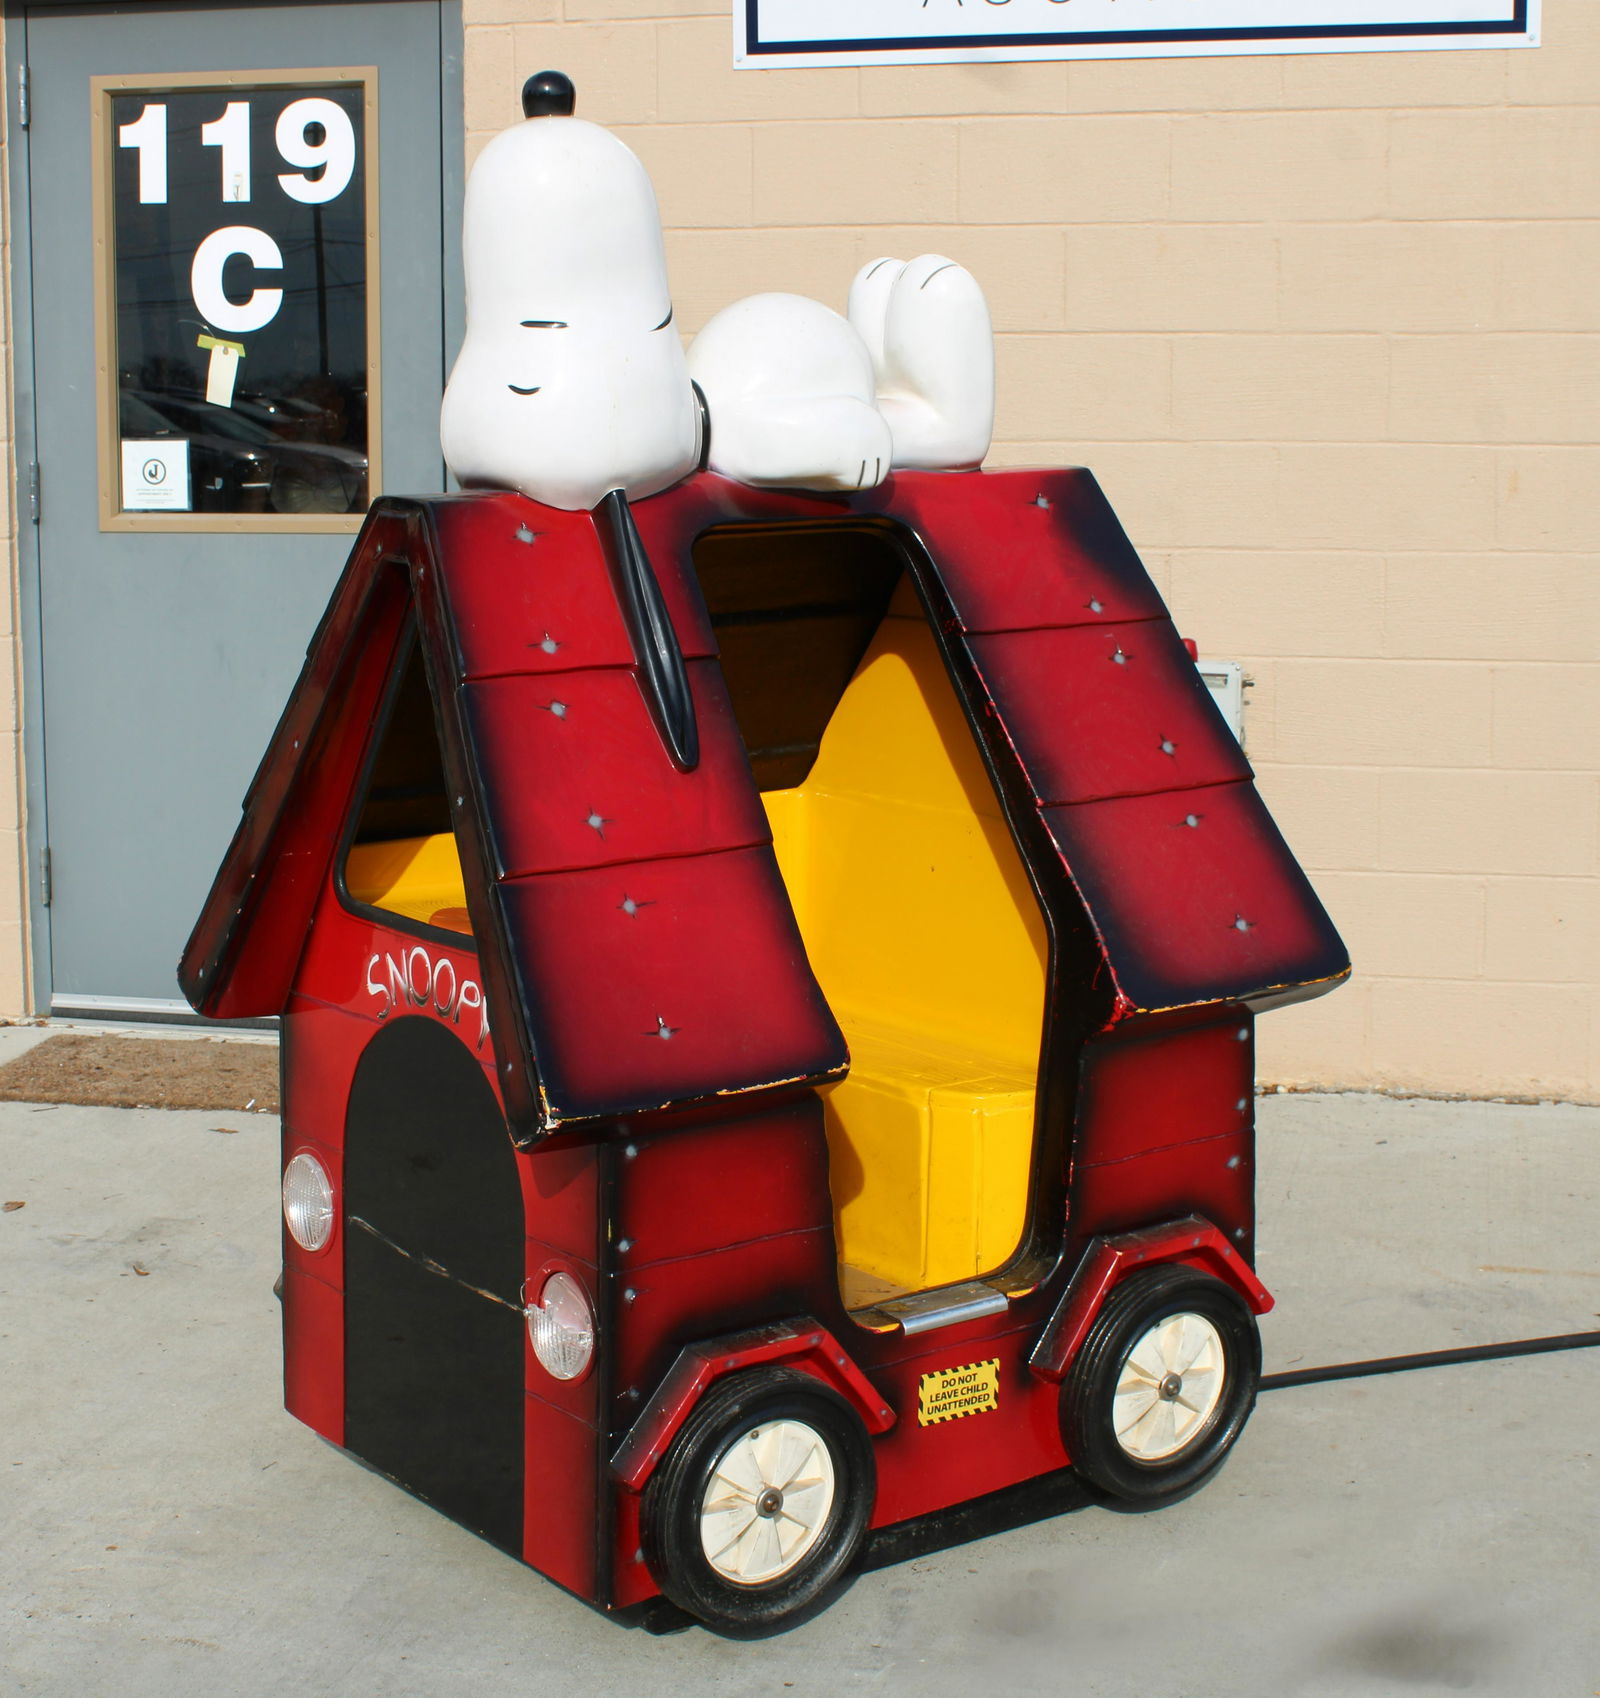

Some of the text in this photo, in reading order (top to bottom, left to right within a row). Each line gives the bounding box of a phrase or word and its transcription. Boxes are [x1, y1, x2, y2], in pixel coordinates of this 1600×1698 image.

[119, 97, 356, 204] 119
[191, 225, 284, 333] C
[941, 1373, 978, 1389] DO NOT
[929, 1382, 989, 1403] LEAVE CHILD
[926, 1393, 990, 1415] UNATTENDED
